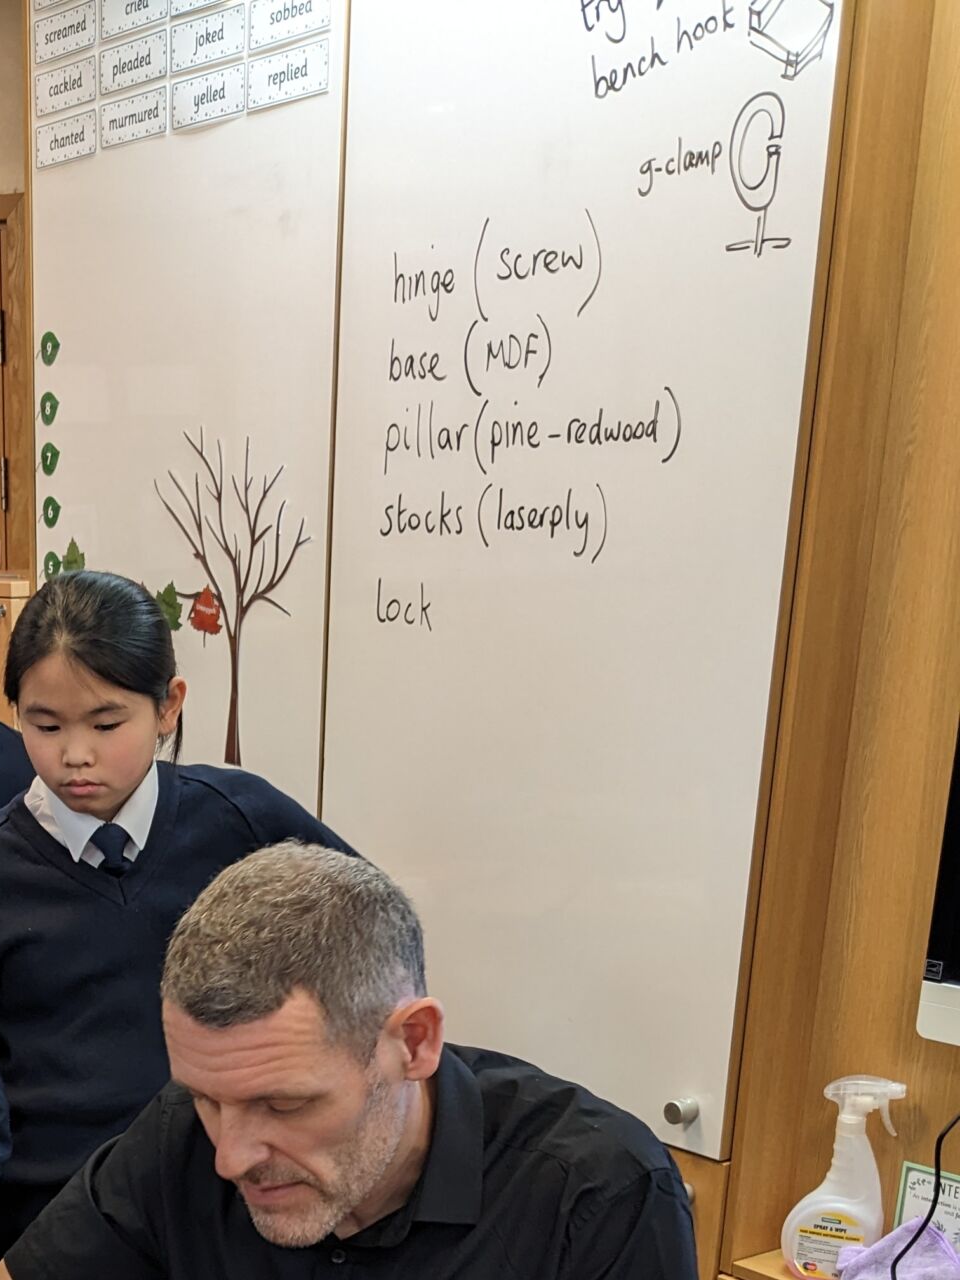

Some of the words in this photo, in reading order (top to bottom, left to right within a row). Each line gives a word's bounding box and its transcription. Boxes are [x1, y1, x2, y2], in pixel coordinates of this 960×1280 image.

[269, 0, 313, 25] sobbed
[43, 17, 87, 45] screamed
[193, 25, 225, 56] joked
[591, 36, 669, 99] bench
[676, 0, 736, 53] hook
[112, 49, 152, 82] pleaded
[267, 59, 308, 91] replied
[48, 72, 83, 98] cackled
[193, 82, 226, 114] yelled
[108, 104, 160, 131] murmured
[49, 126, 85, 152] chanted
[637, 137, 723, 197] g-clamp
[393, 244, 456, 322] hinge
[46, 342, 53, 355] 9
[389, 338, 448, 383] base
[464, 312, 552, 397] (MDF)
[44, 402, 51, 415] 8
[46, 452, 52, 464] 7
[47, 506, 54, 518] 6
[380, 491, 464, 540] stocks
[477, 482, 608, 564] (laserply)
[48, 562, 54, 574] 5
[376, 577, 434, 633] lock
[935, 1180, 960, 1200] NTE
[813, 1223, 828, 1231] SPRAY
